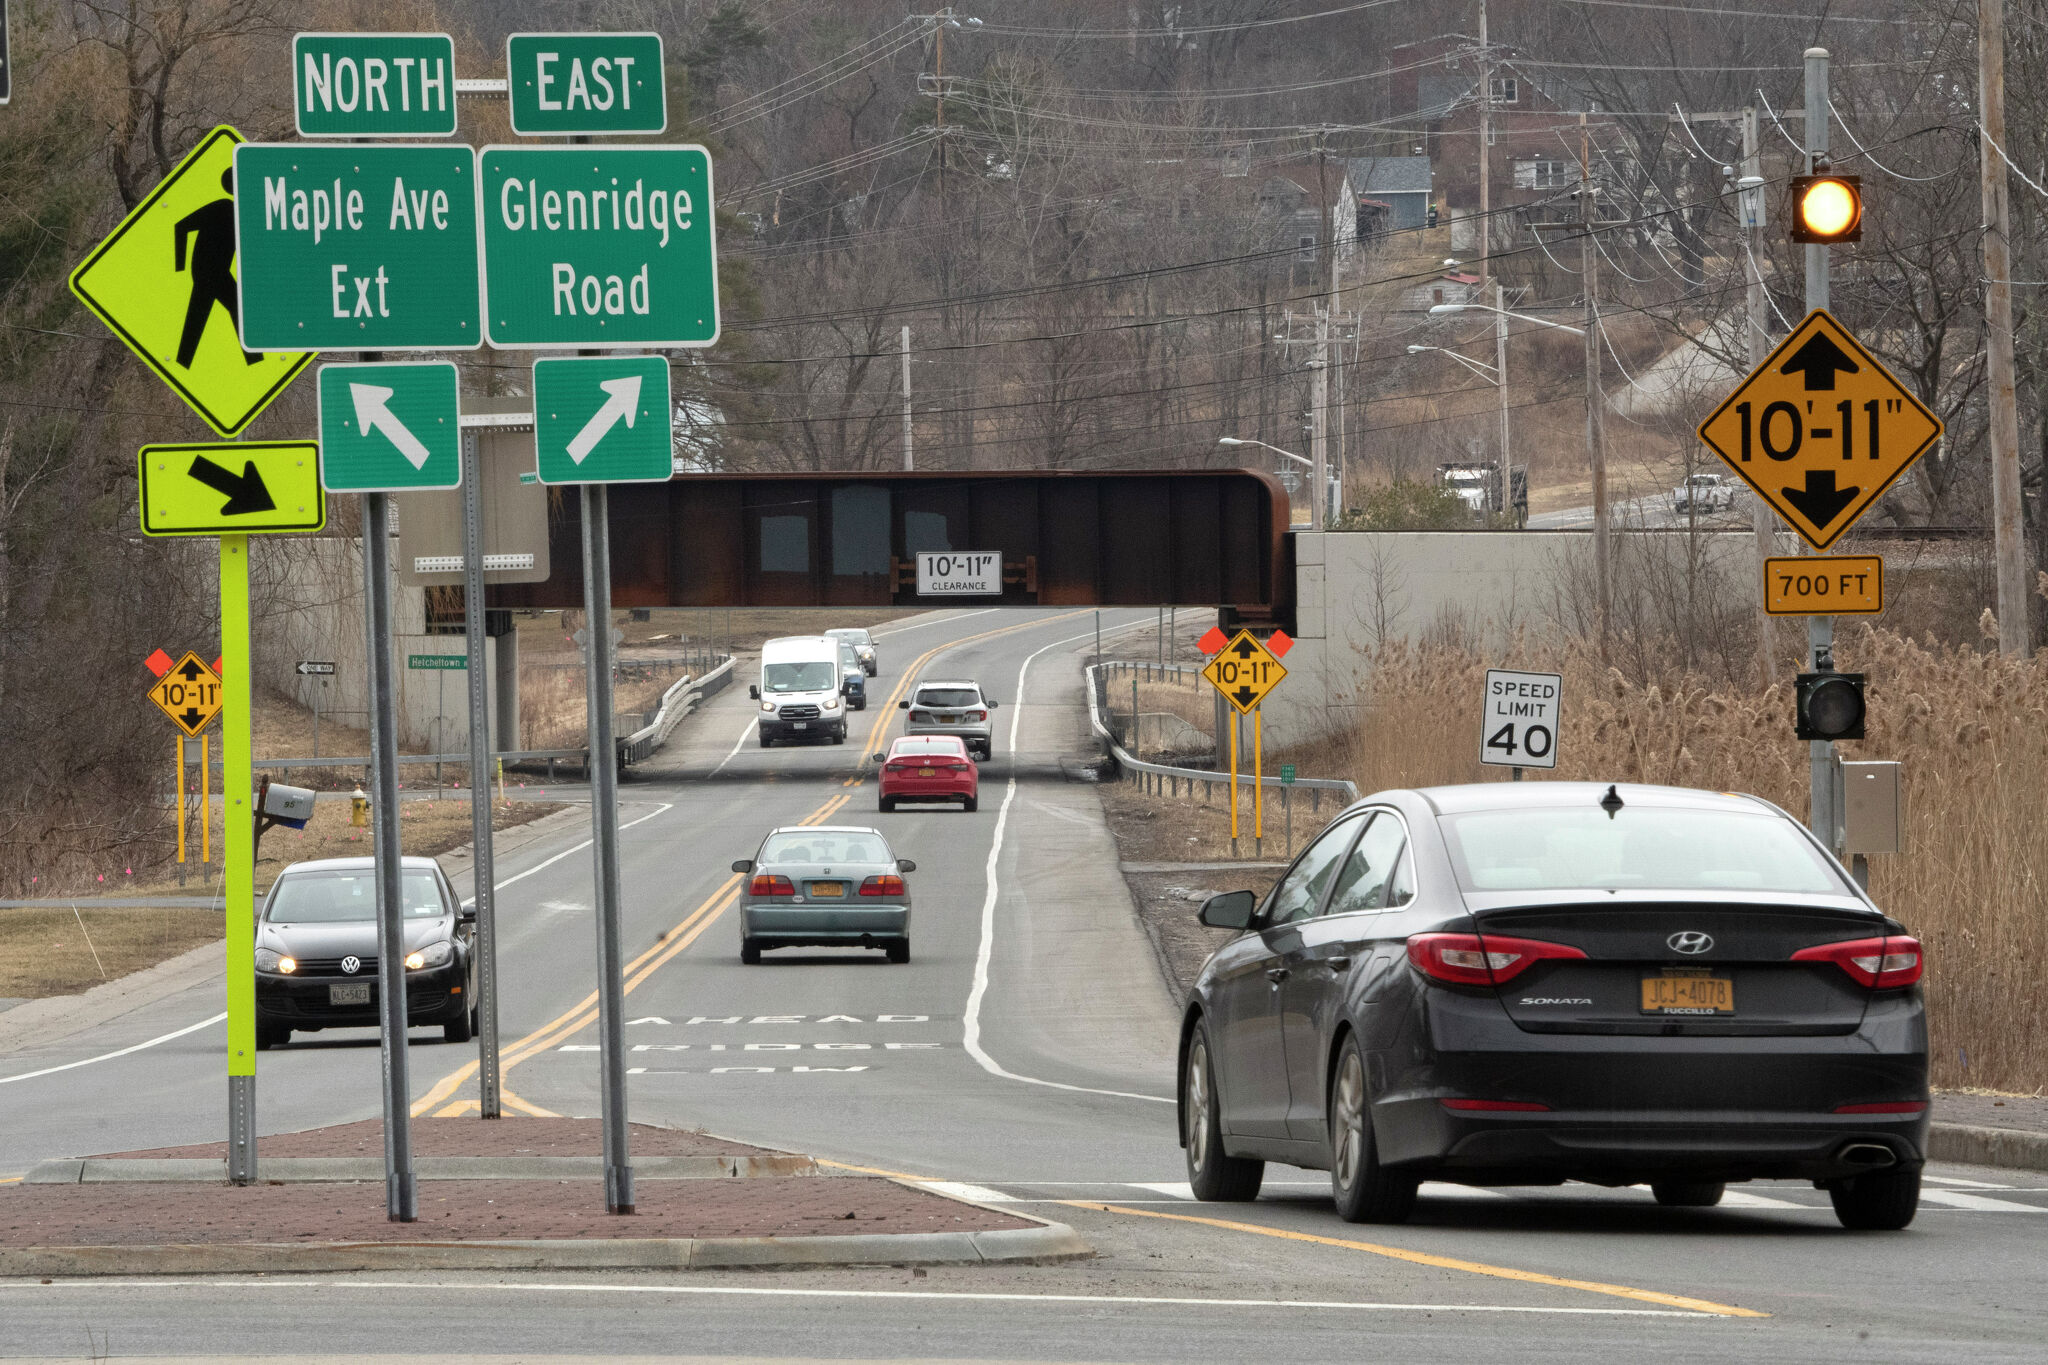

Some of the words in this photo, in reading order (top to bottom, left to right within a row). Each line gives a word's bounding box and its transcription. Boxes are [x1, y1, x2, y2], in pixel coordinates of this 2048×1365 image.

[305, 52, 446, 113] NORTH
[536, 52, 635, 111] EAST
[265, 176, 364, 245] Maple
[389, 176, 449, 230] Ave
[501, 178, 693, 249] Glenridge
[331, 264, 390, 318] Ext
[552, 262, 650, 316] Road
[1736, 399, 1902, 462] 10'-11"
[931, 582, 987, 591] CLEARANCE
[1778, 576, 1830, 597] 700
[1839, 574, 1868, 595] FT
[1492, 681, 1554, 698] SPEED
[1497, 701, 1546, 717] LIMIT
[1487, 722, 1551, 758] 40
[1519, 997, 1592, 1005] SONATA
[1663, 1007, 1714, 1015] FUCCILLO
[624, 1015, 930, 1025] AHEAD
[626, 1066, 869, 1075] LOW
